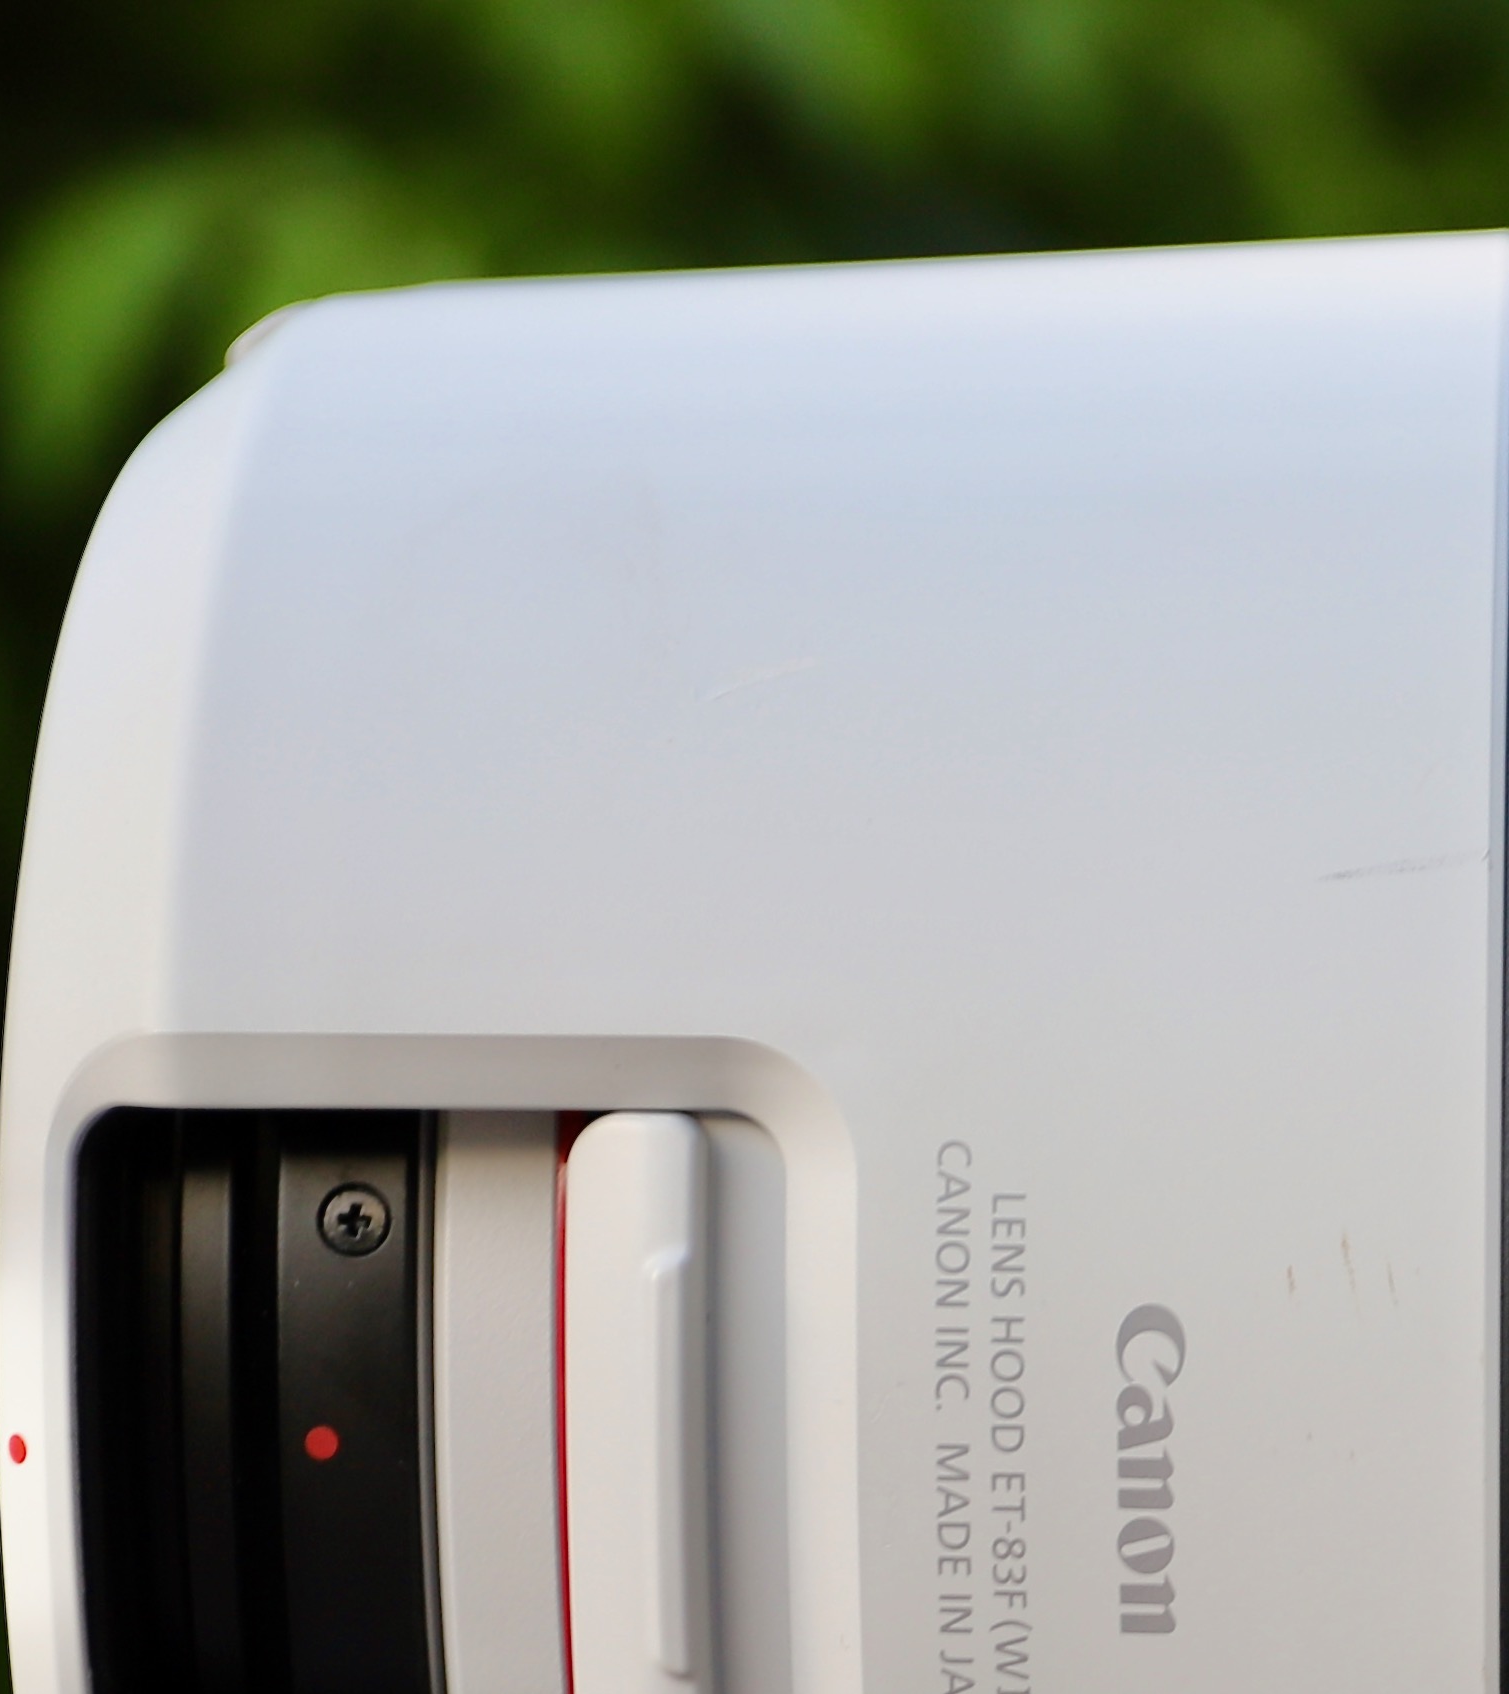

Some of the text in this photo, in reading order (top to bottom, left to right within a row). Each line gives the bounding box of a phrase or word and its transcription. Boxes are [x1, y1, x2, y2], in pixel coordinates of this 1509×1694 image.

[936, 1139, 973, 1309] CANON
[991, 1192, 1026, 1299] LENS
[935, 1325, 970, 1412] INC.
[990, 1315, 1026, 1454] HOOD
[936, 1443, 972, 1578] MADE
[1115, 1302, 1187, 1635] Canon
[938, 1594, 972, 1635] IN
